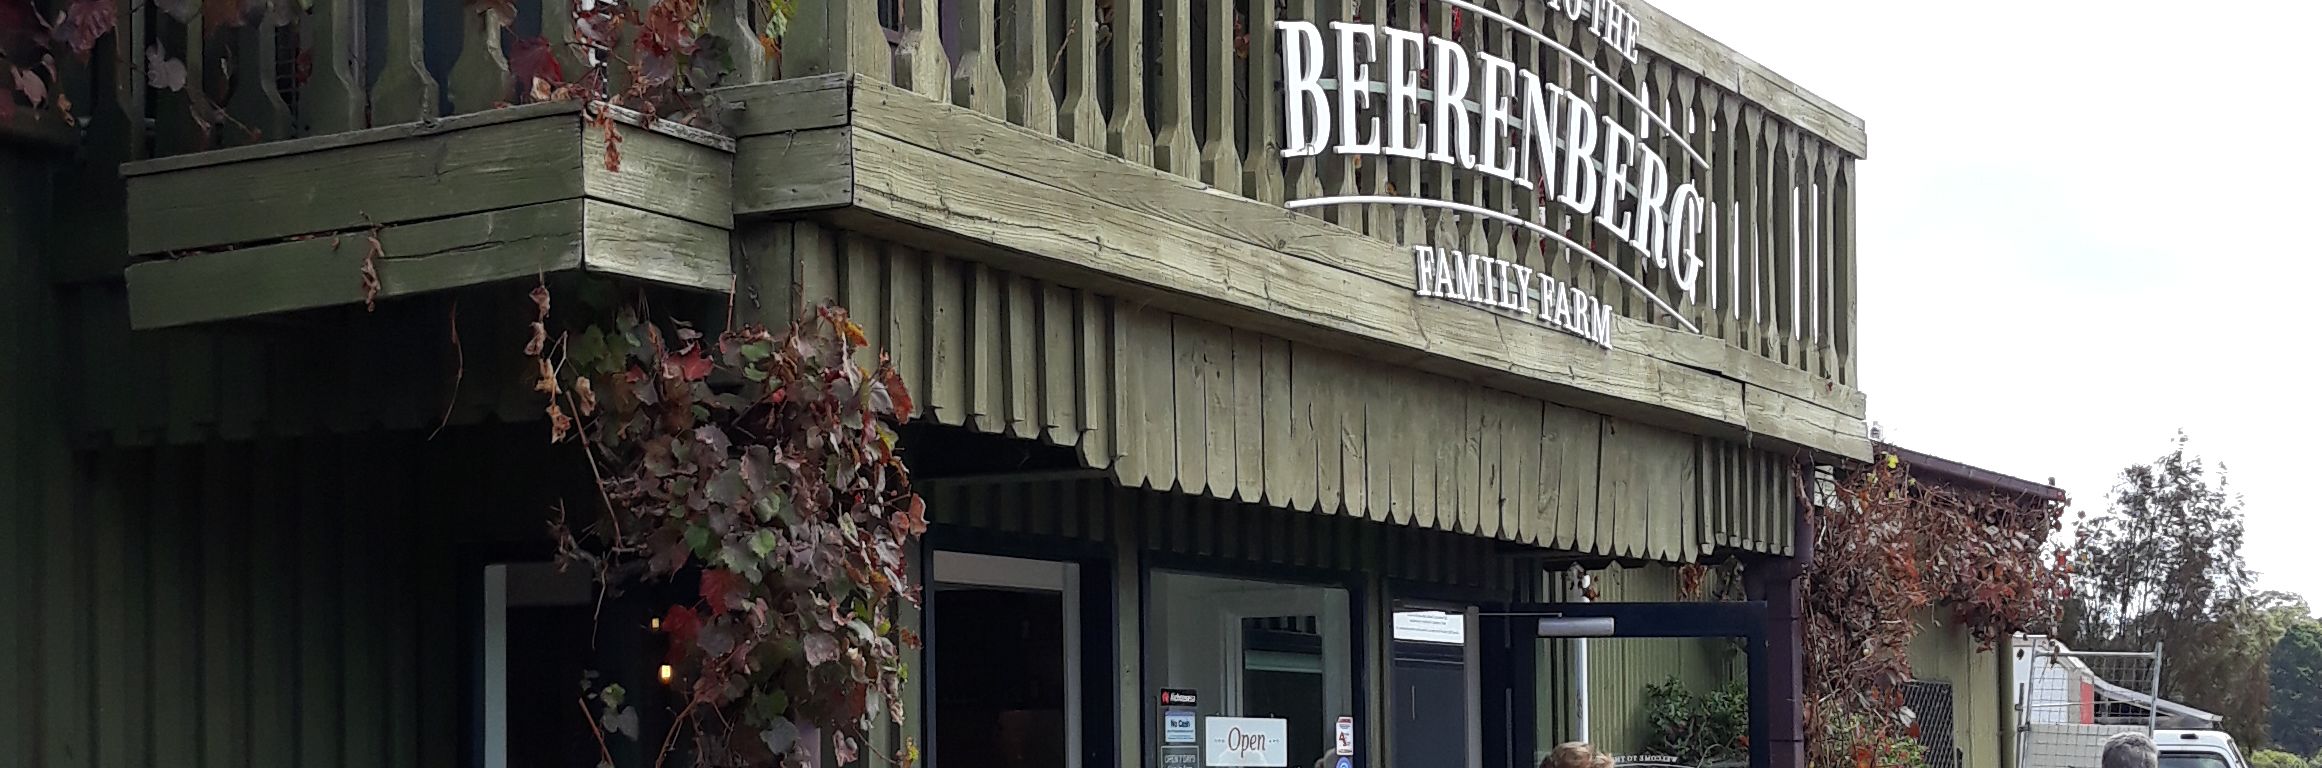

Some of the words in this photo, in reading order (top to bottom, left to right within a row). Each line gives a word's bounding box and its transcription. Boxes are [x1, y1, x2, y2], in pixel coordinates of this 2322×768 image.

[1588, 0, 1639, 64] THE
[1275, 20, 1704, 293] BEERENBERG
[1414, 245, 1532, 314] FAMILY
[1538, 272, 1613, 349] FARM
[1228, 727, 1266, 758] Open
